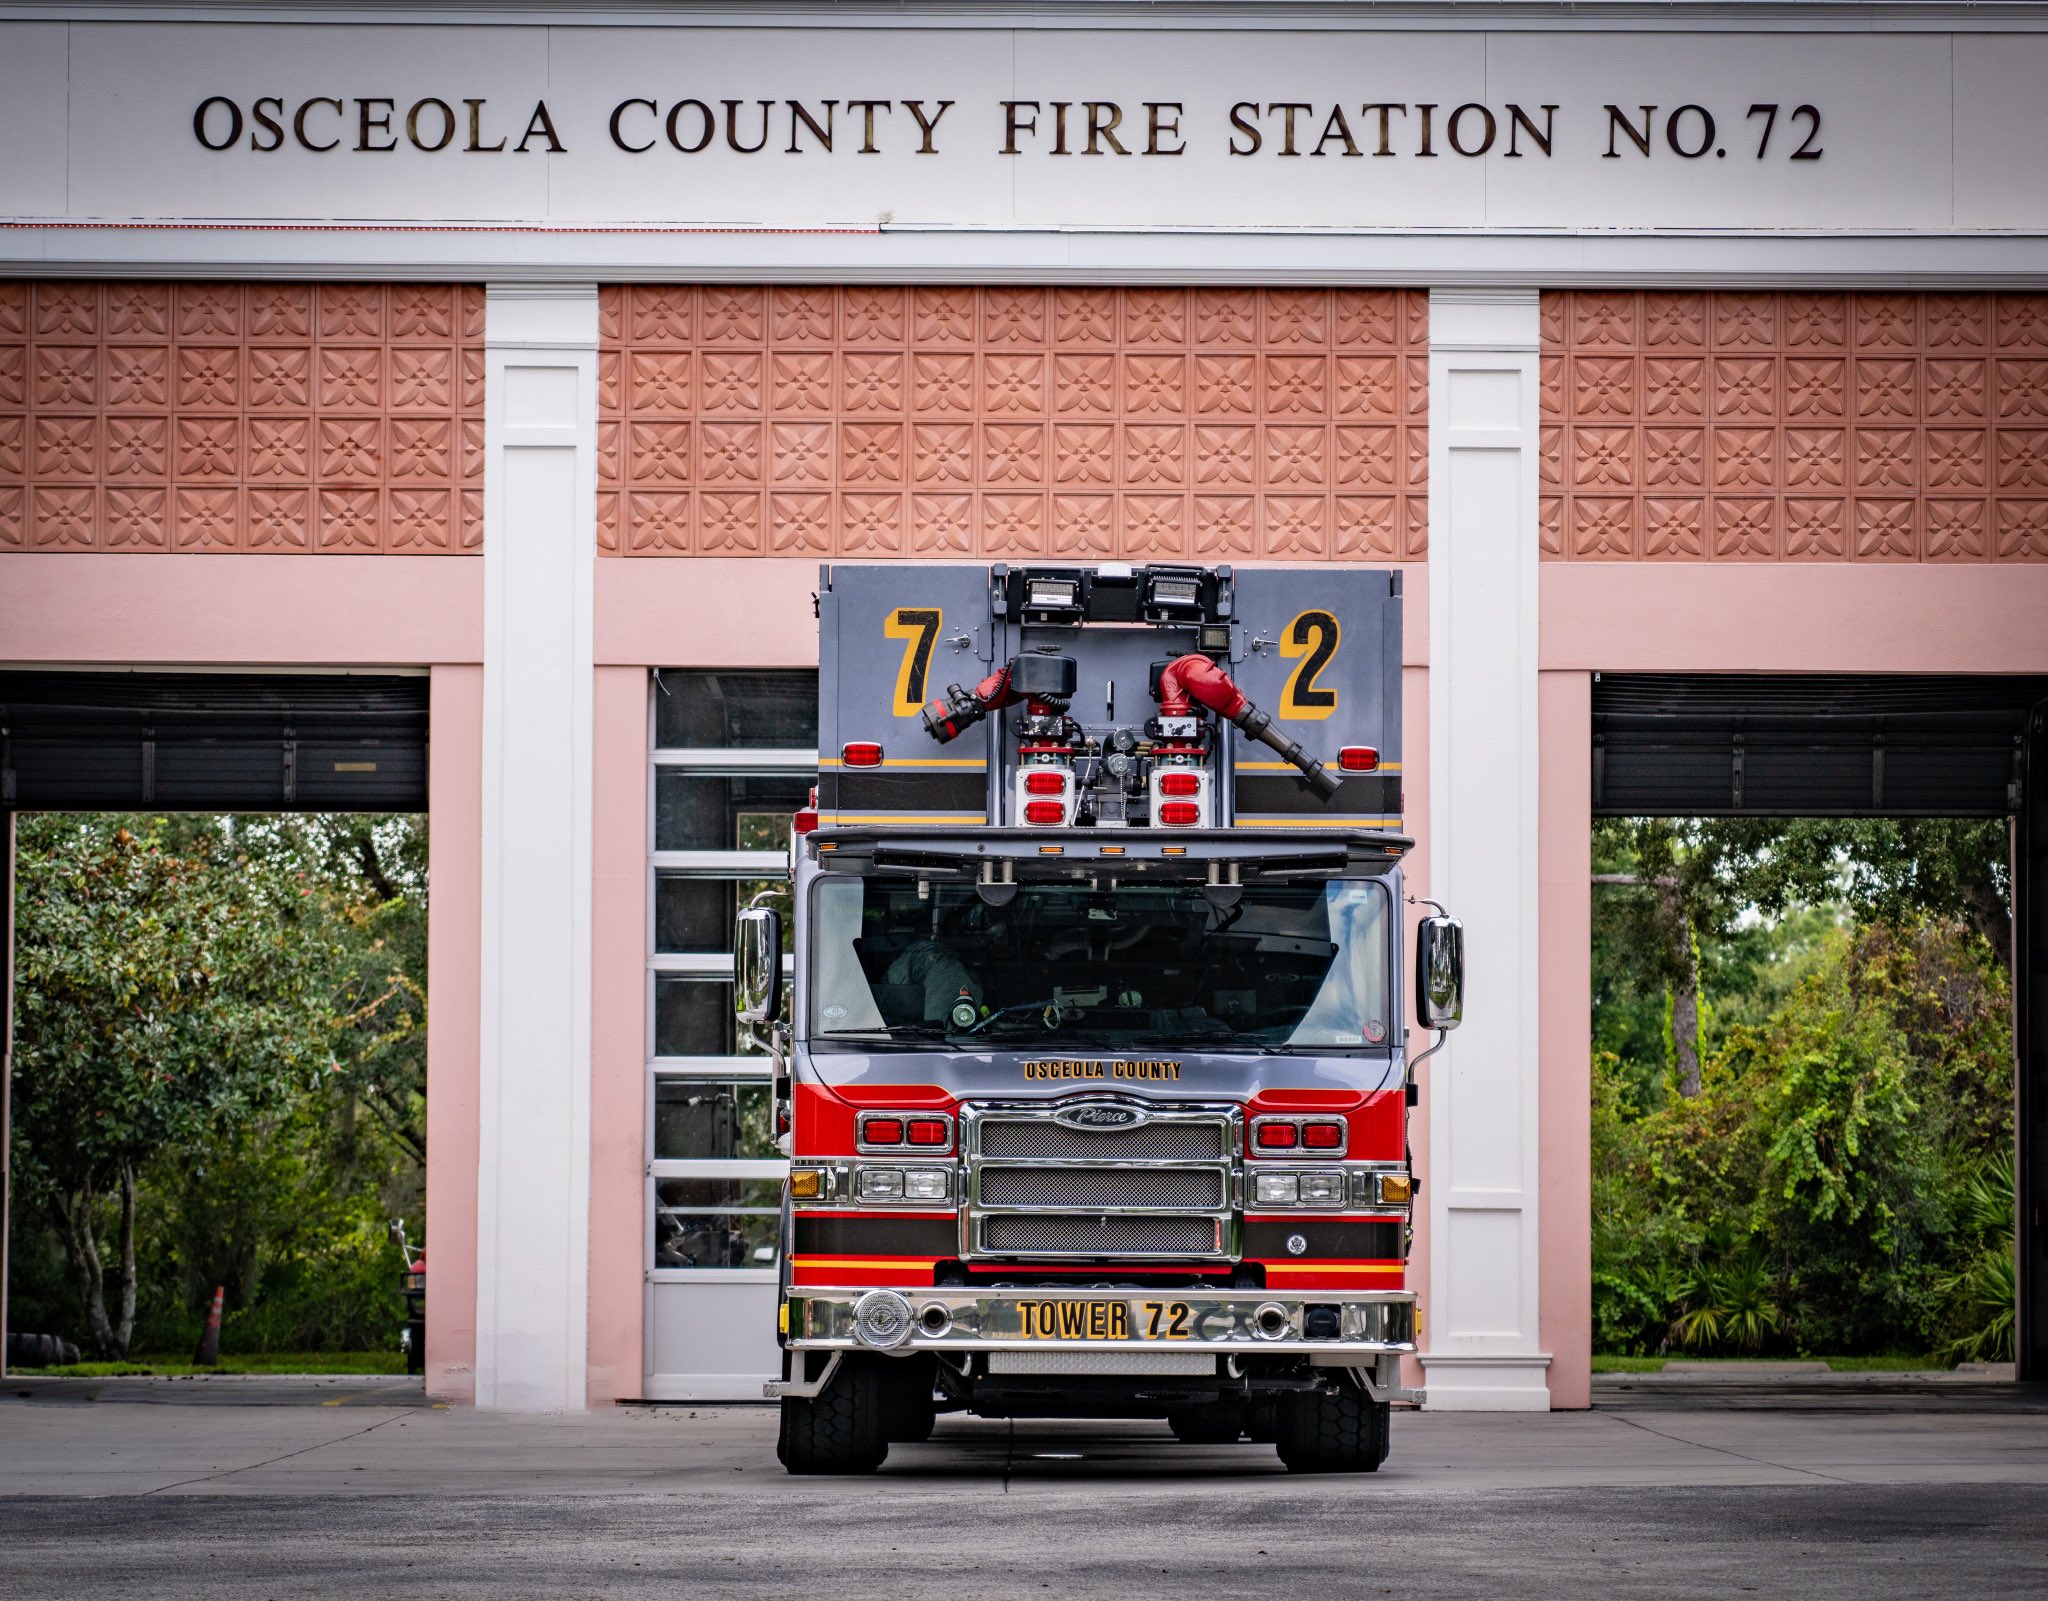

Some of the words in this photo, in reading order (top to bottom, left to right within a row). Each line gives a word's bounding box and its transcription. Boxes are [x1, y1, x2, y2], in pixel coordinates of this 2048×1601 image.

[193, 95, 568, 153] OSCEOLA
[609, 98, 956, 154] COUNTY
[998, 100, 1188, 156] FIRE
[1229, 101, 1560, 158] STATION
[1601, 103, 1727, 160] NO.
[1746, 103, 1824, 161] 72
[884, 607, 943, 717] 7
[1279, 608, 1341, 721] 2
[1024, 1060, 1105, 1080] OSCEOLA
[1113, 1060, 1182, 1081] COUNTY
[1077, 1107, 1128, 1124] Pierce
[1016, 1301, 1129, 1340] TOWER
[1143, 1301, 1190, 1340] 72
